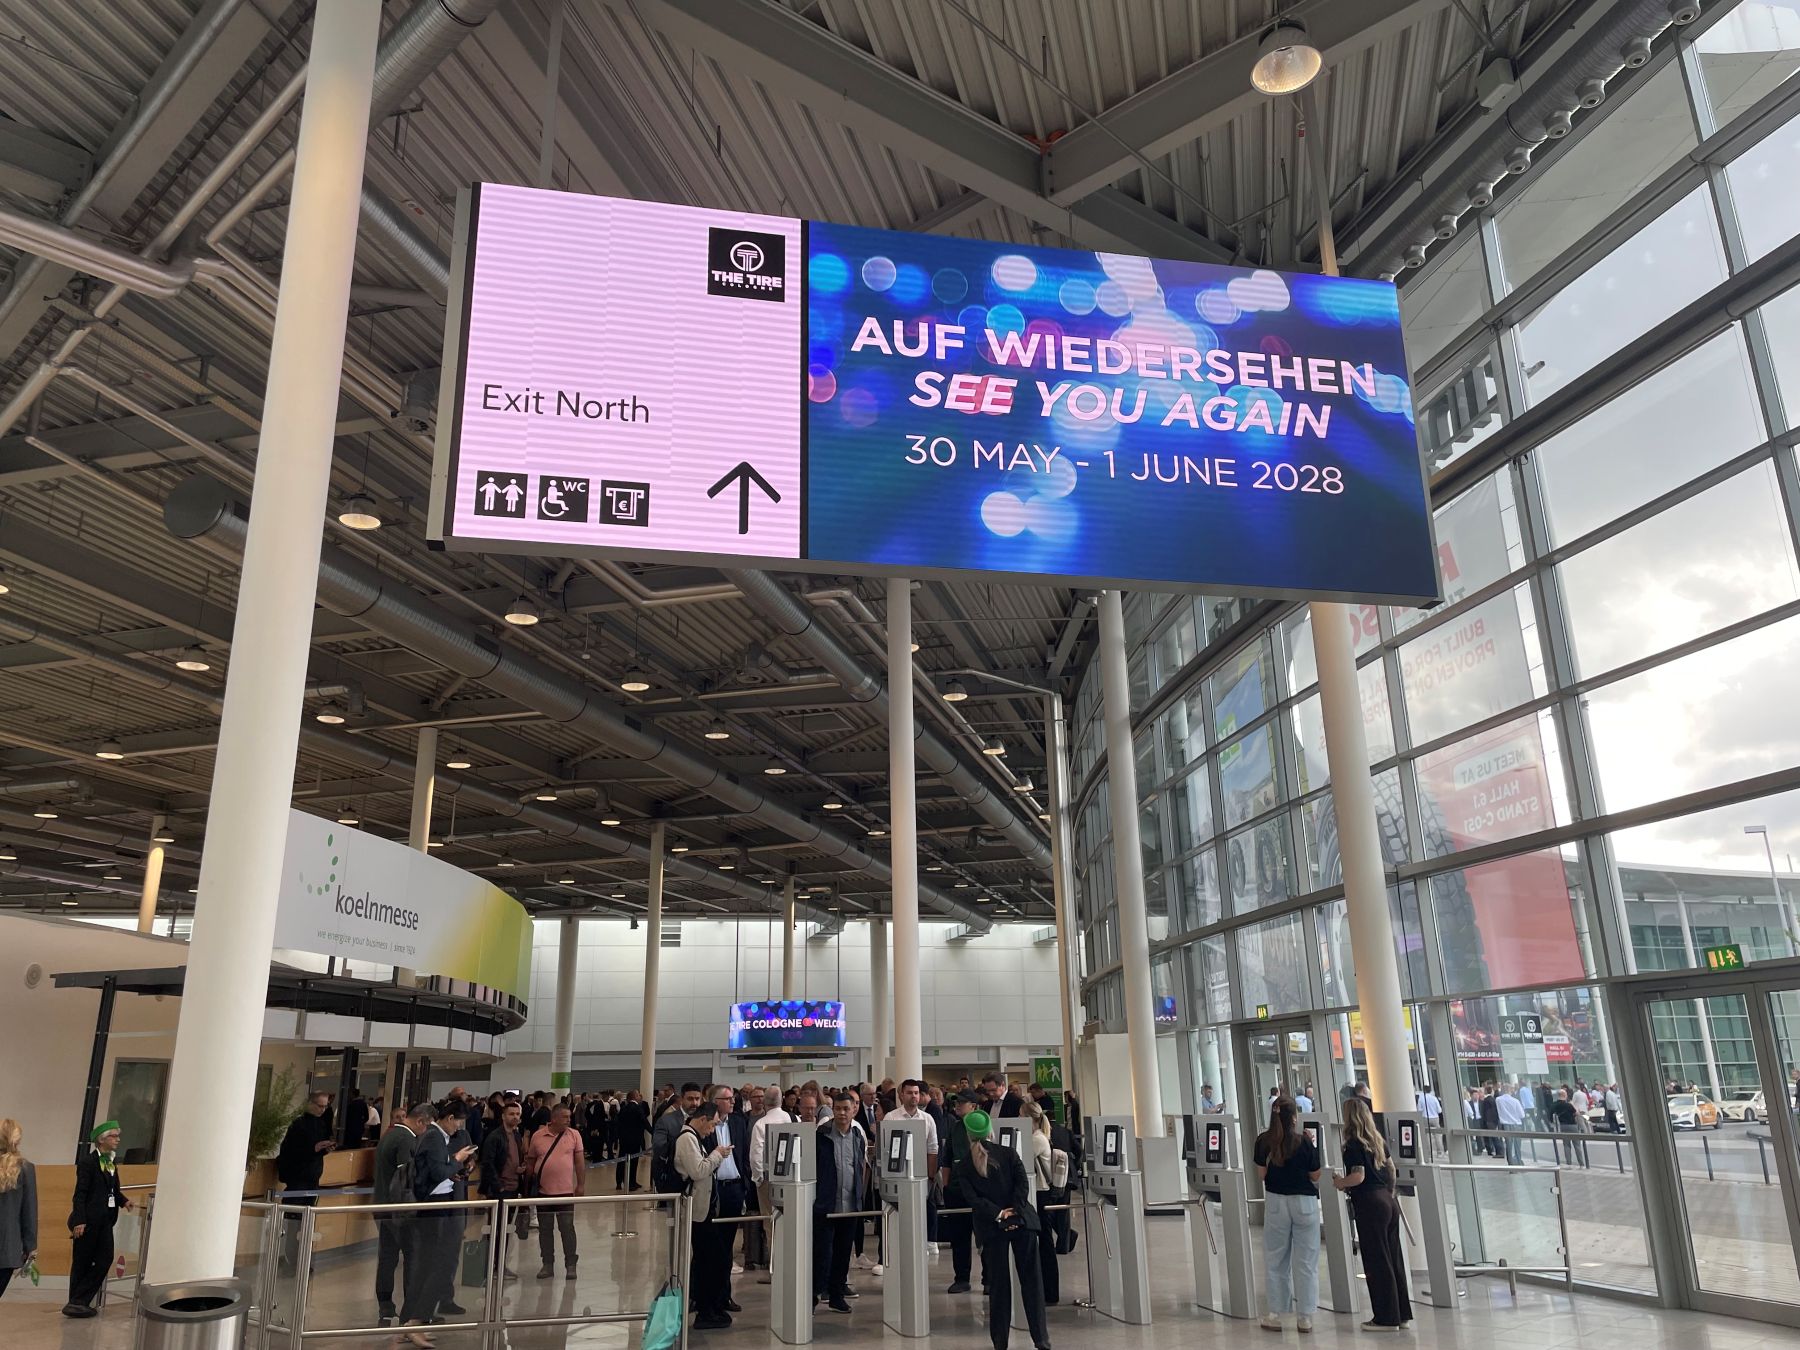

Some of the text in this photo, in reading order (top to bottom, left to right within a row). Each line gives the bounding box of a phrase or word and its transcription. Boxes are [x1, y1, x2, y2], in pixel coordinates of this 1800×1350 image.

[711, 270, 783, 288] THE TIRE
[850, 316, 1378, 397] AUF WIEDERSEHEN
[482, 383, 650, 424] Exit North
[908, 370, 1332, 439] SEE YOU AGAIN
[562, 480, 587, 493] WC
[904, 434, 957, 467] 30
[973, 440, 1061, 474] MAY
[1103, 450, 1115, 479] 1
[1131, 452, 1239, 487] JUNE
[1251, 460, 1345, 495] 2028
[335, 884, 419, 931] koelnmesse
[752, 1018, 803, 1029] COLOGNE
